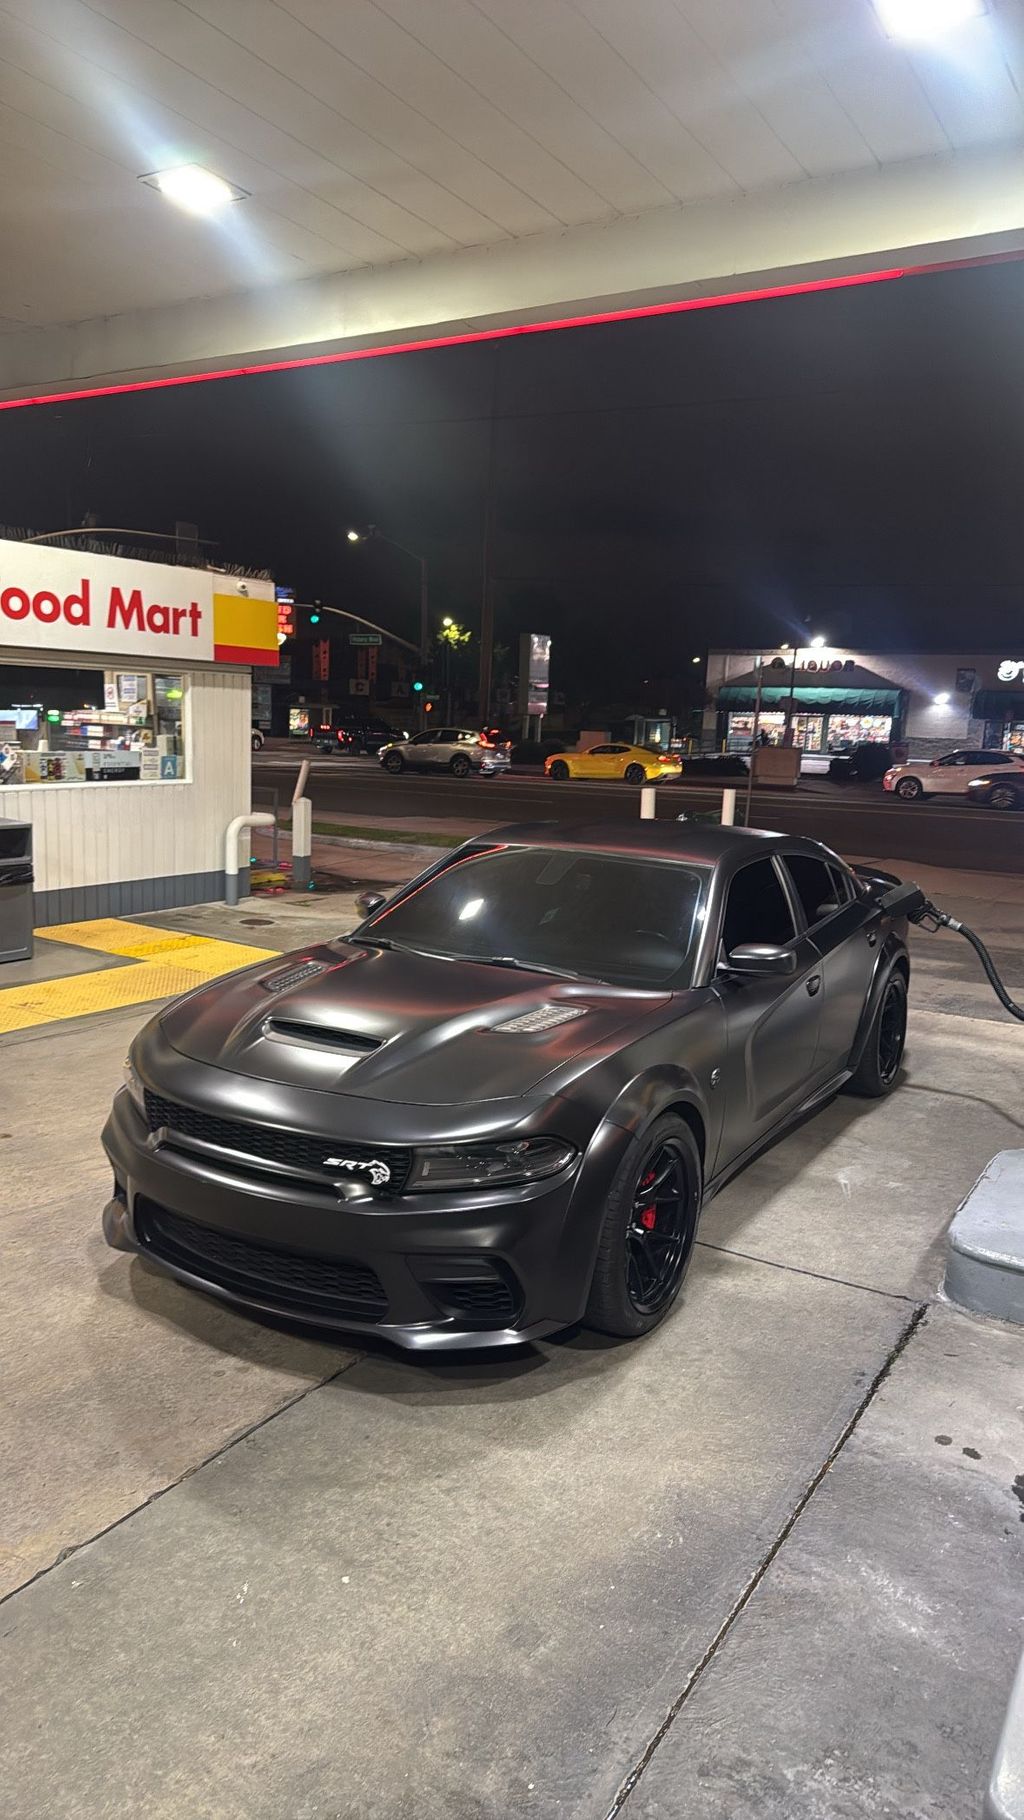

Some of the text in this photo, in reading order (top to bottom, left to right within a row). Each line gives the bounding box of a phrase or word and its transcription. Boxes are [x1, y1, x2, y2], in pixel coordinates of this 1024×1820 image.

[0, 578, 201, 636] ood Mart
[164, 761, 174, 775] A
[323, 1157, 369, 1170] SRT
